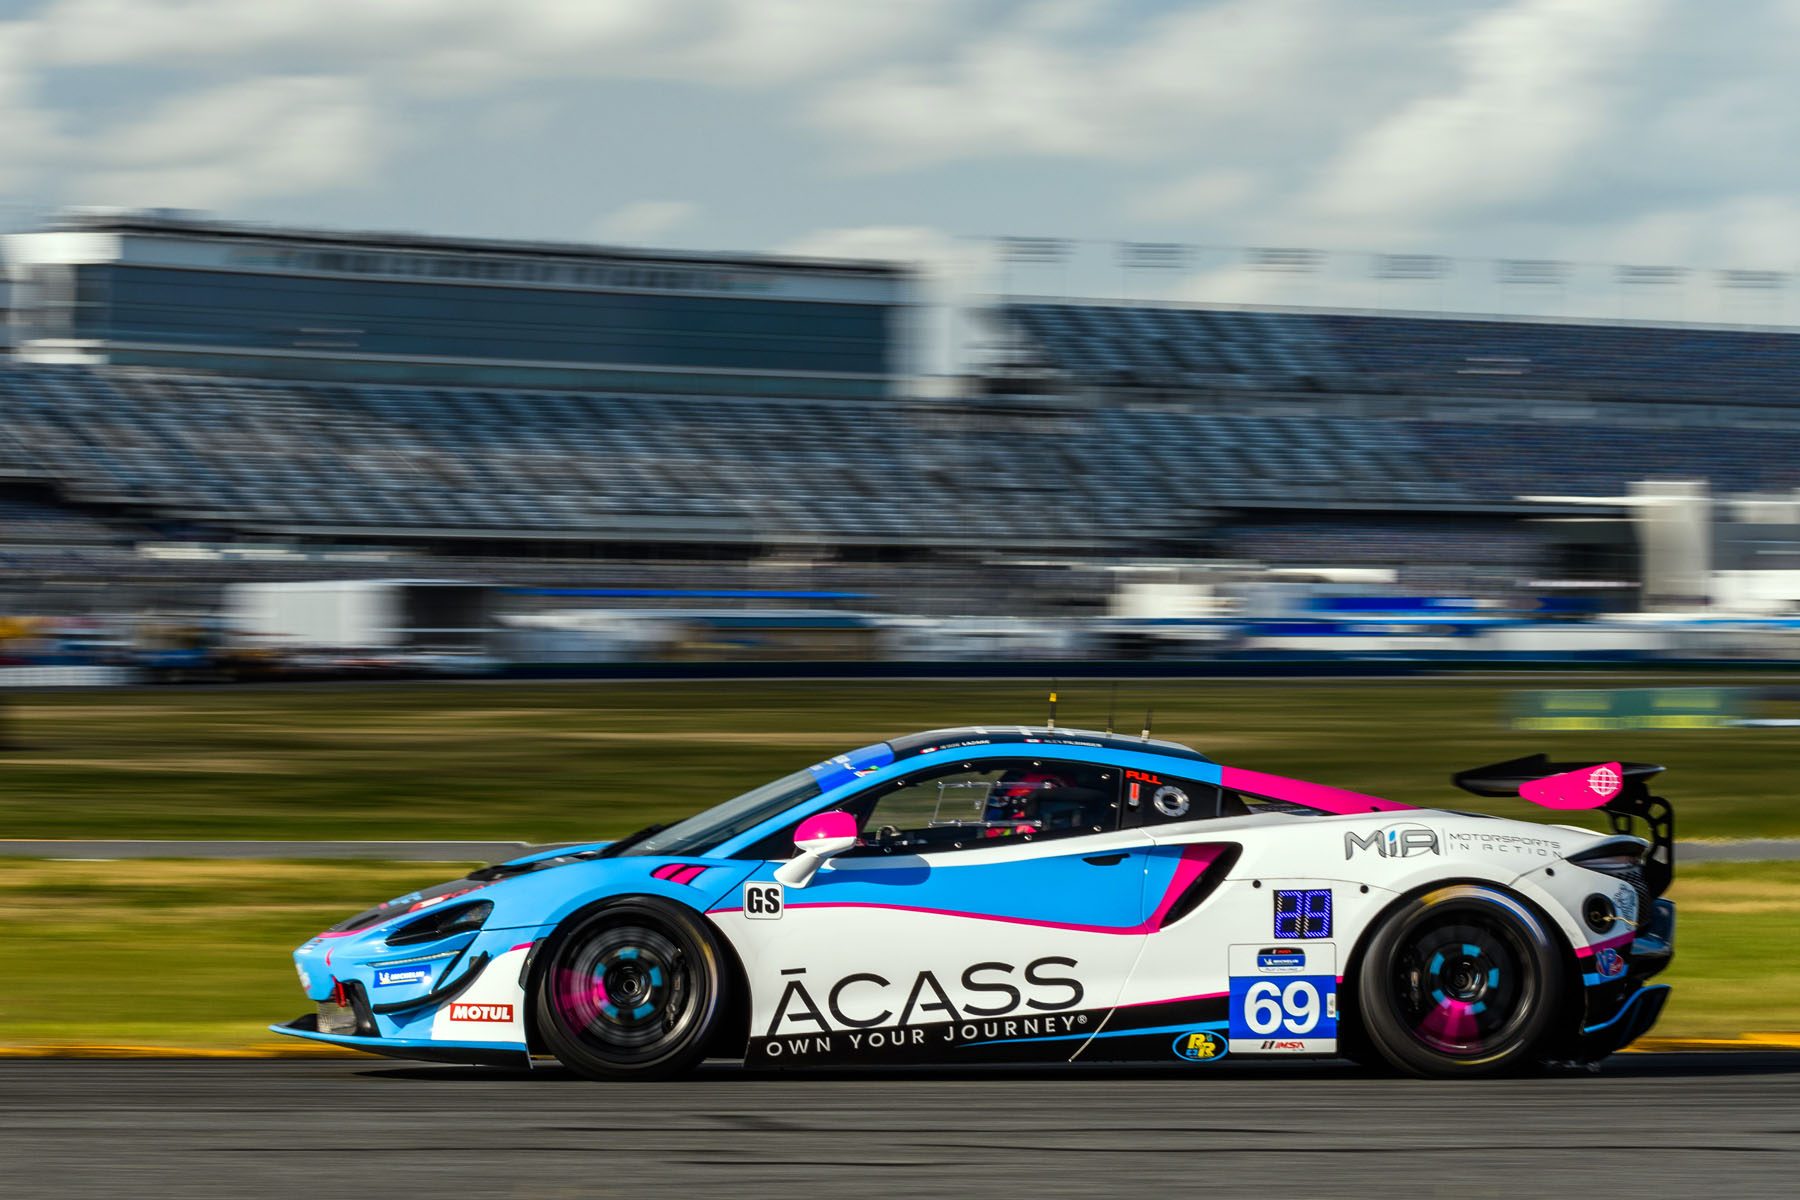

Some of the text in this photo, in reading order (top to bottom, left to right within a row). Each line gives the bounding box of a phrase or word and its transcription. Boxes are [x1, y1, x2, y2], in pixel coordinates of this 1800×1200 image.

[1125, 770, 1163, 785] FULL
[1449, 833, 1560, 849] MOTORSPORTS
[1450, 843, 1564, 860] IN ACTION
[747, 887, 780, 914] GS
[452, 1005, 511, 1020] MOTUL
[1244, 980, 1320, 1035] 69
[766, 1037, 831, 1056] OWN
[849, 1029, 925, 1049] YOUR
[1274, 1041, 1304, 1049] IMSA
